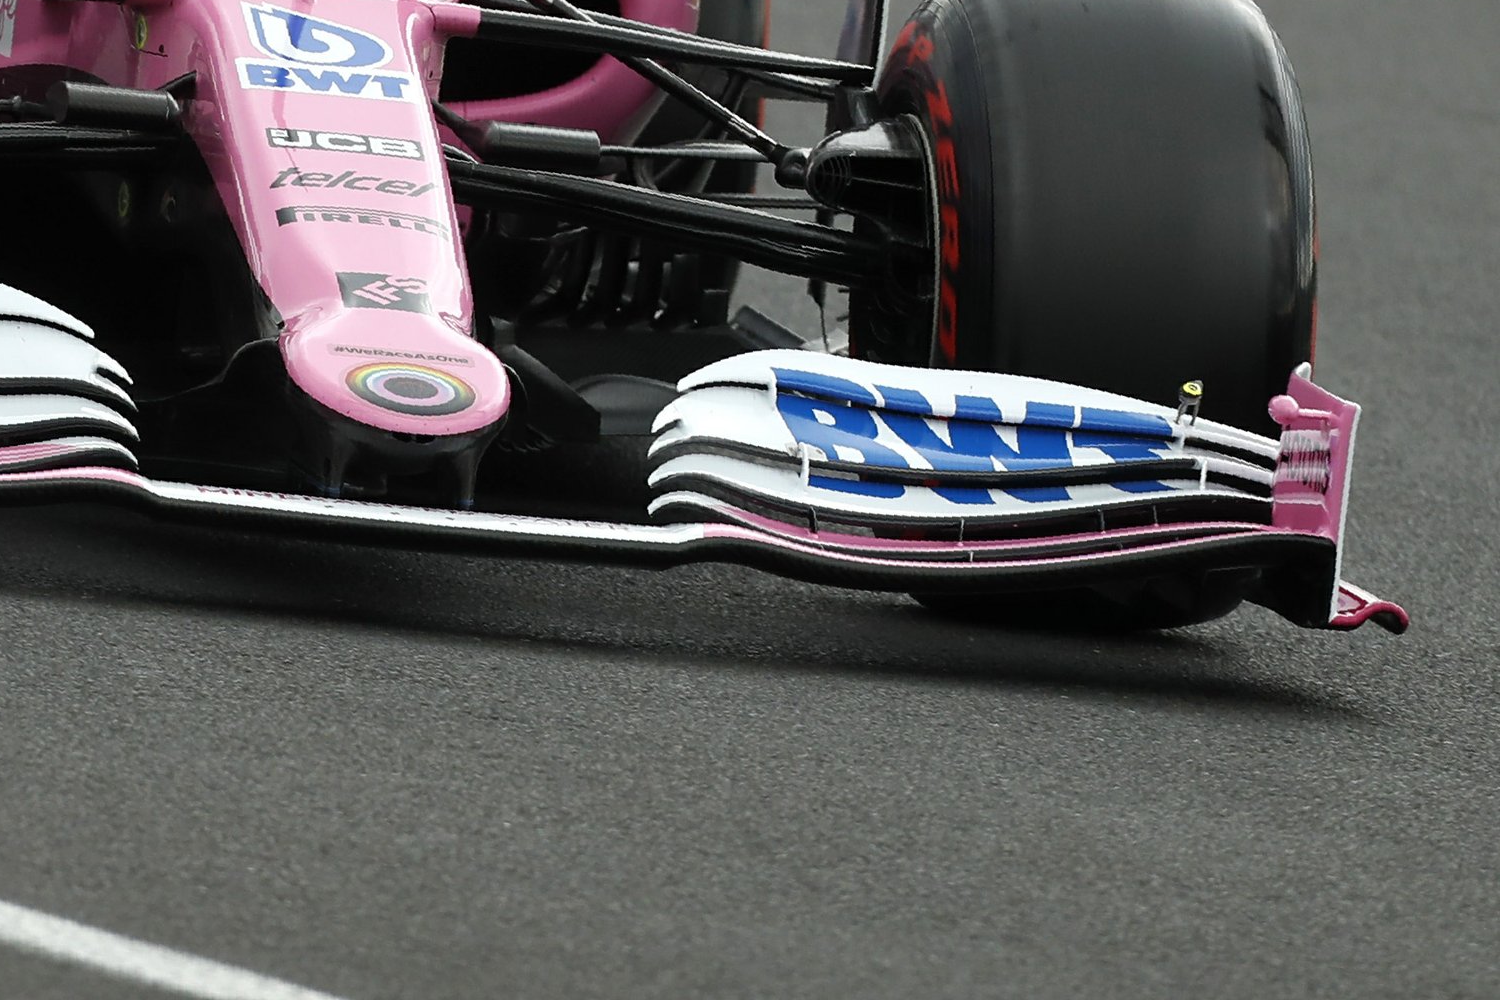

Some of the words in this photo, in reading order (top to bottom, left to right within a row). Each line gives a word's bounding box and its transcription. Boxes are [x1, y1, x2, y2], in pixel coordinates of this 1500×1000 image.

[246, 63, 410, 99] BWT
[269, 127, 423, 160] JCB
[269, 166, 438, 198] telcel
[926, 80, 960, 363] ZERO
[352, 276, 429, 306] IFS
[334, 345, 470, 364] #WeRaceAsOne
[770, 366, 1176, 505] BWT
